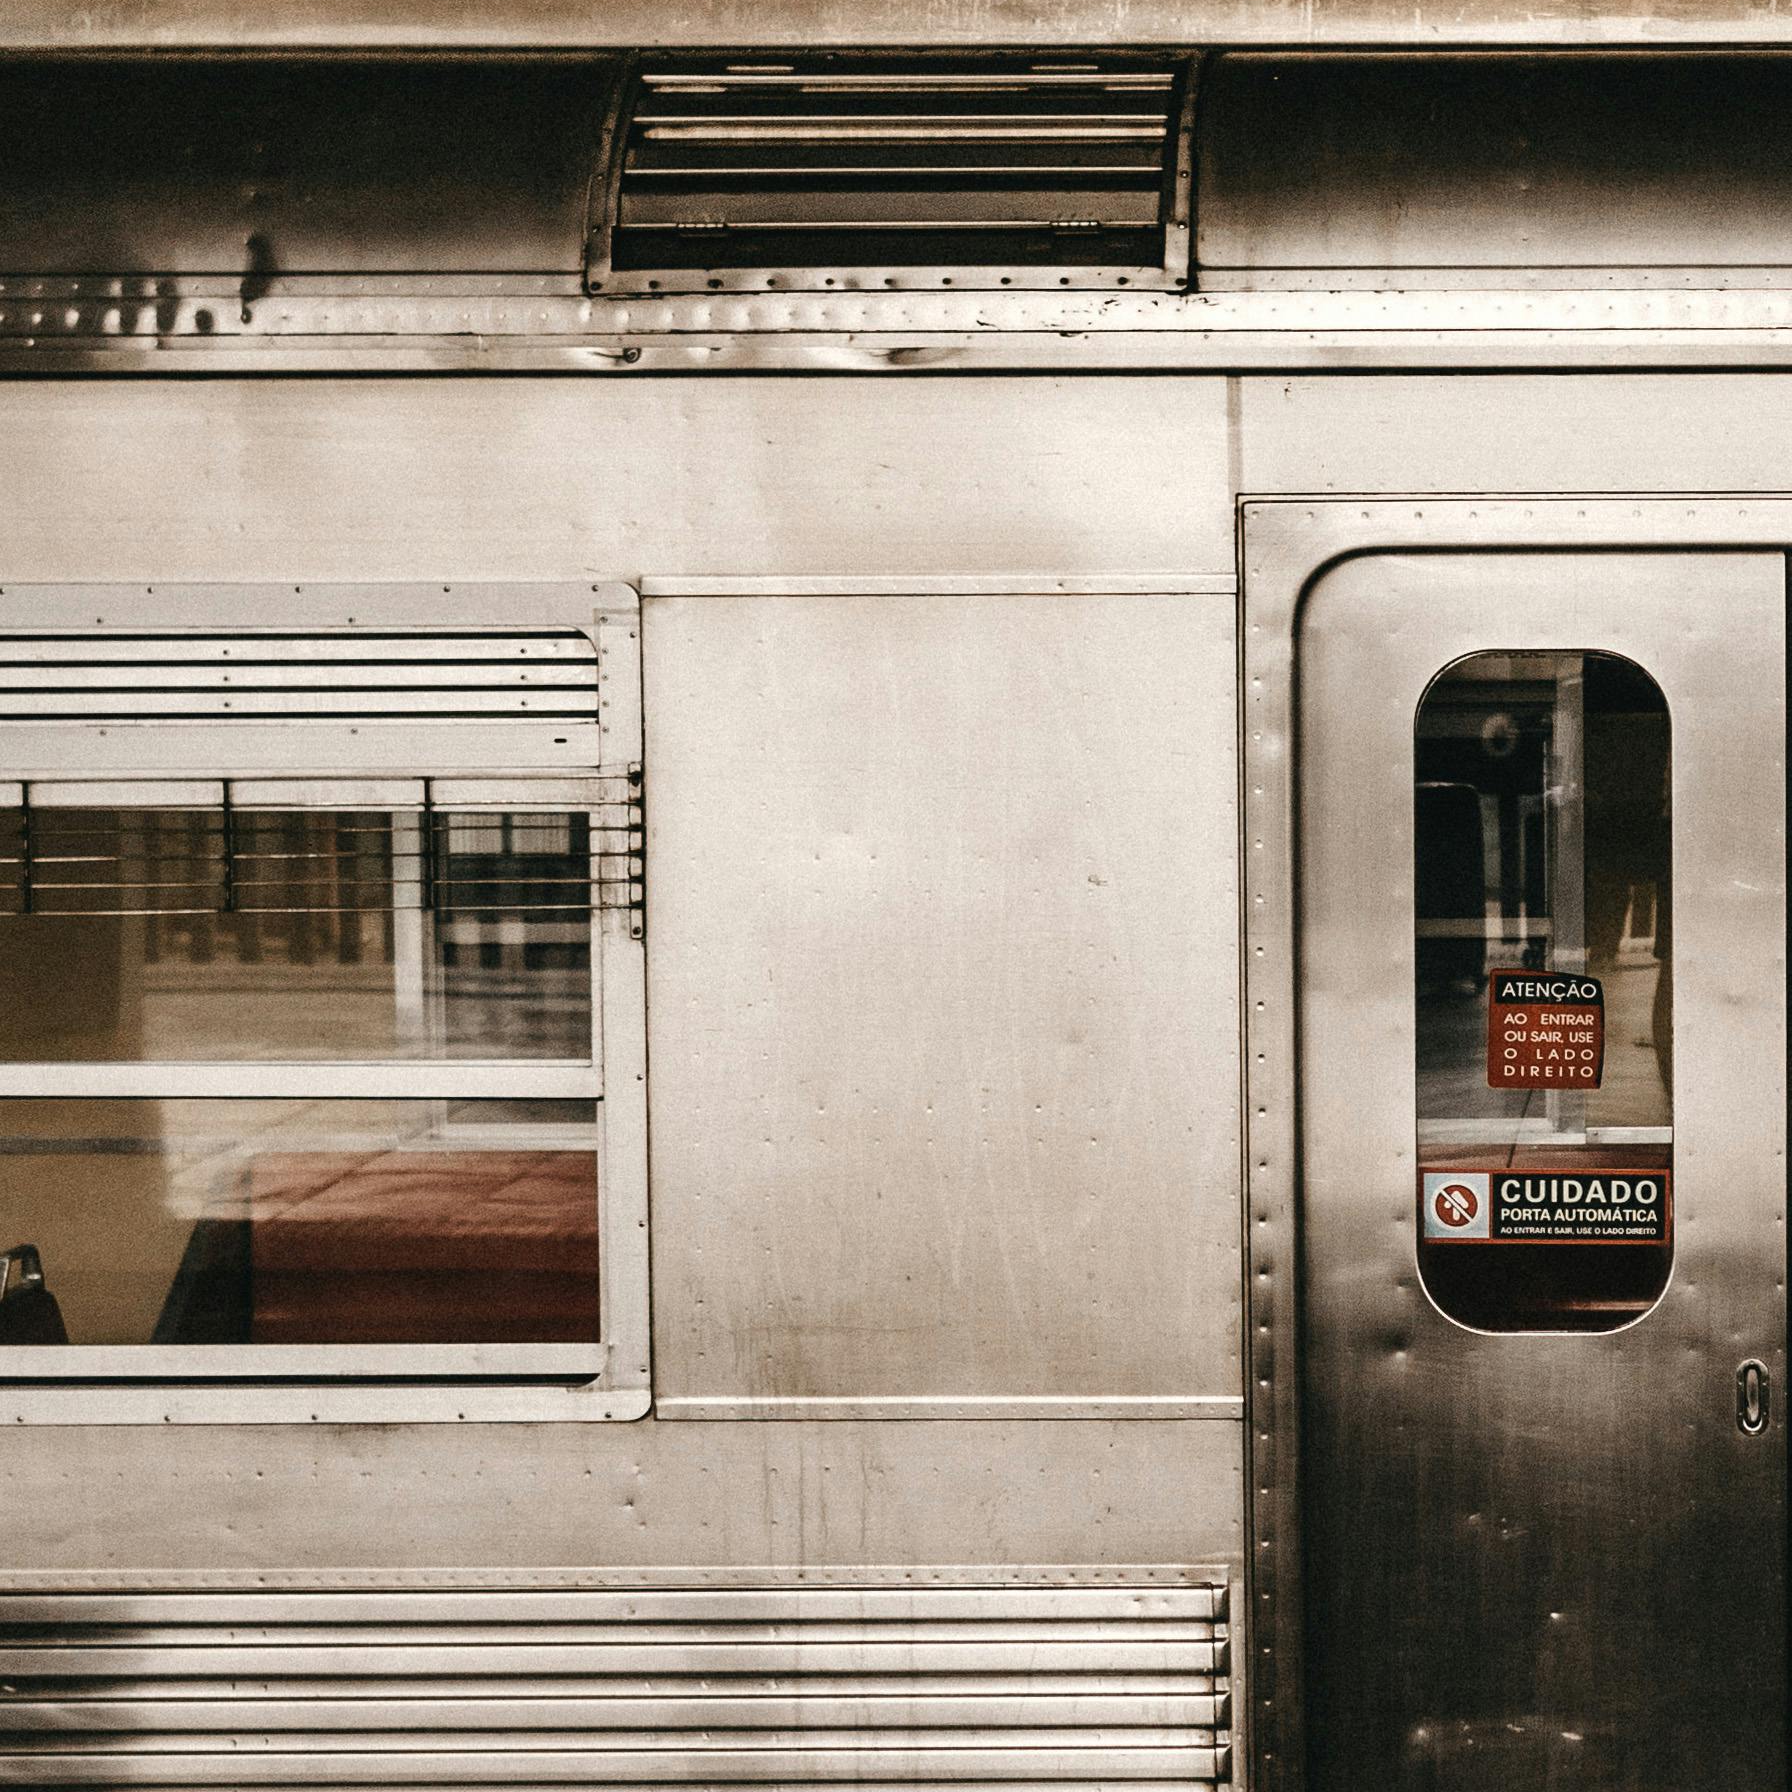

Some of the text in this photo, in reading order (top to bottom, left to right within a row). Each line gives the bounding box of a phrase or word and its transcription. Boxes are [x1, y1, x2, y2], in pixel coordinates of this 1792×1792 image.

[1502, 979, 1597, 1002] ATENÇÃO
[1504, 1012, 1595, 1026] AO ENTRAR
[1504, 1030, 1527, 1042] OU
[1569, 1031, 1594, 1043] USE
[1504, 1047, 1594, 1061] O LADO
[1504, 1064, 1594, 1078] DIREITO
[1500, 1179, 1658, 1205] CUIDADO
[1501, 1206, 1658, 1222] PORTA AUTOMÁTICA
[1500, 1226, 1513, 1235] AO
[1513, 1226, 1546, 1235] ENTRAR
[1576, 1226, 1592, 1235] USE
[1594, 1226, 1601, 1235] O
[1602, 1227, 1624, 1235] LADO
[1625, 1227, 1657, 1235] DIREITO
